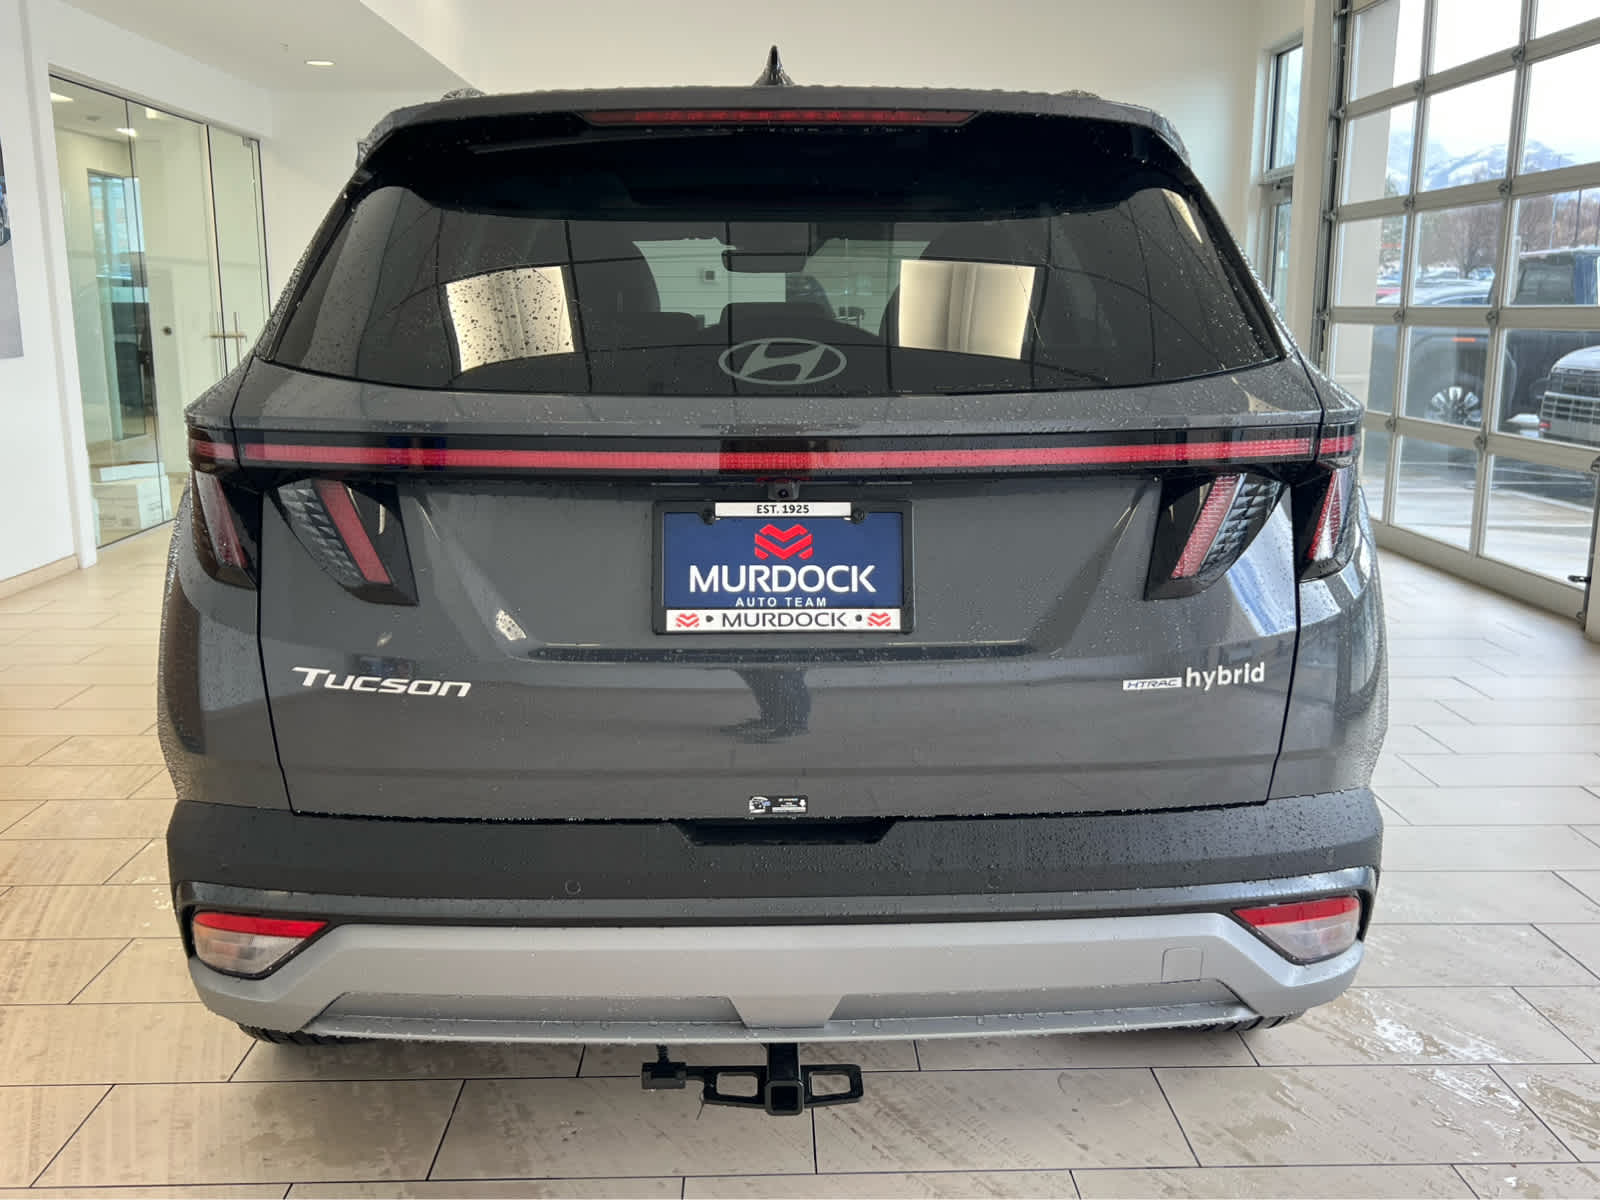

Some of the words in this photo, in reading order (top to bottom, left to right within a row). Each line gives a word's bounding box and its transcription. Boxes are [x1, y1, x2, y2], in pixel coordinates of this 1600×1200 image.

[756, 504, 780, 514] EST.
[782, 504, 810, 514] 1925
[689, 565, 877, 593] MURDOCK
[735, 597, 777, 607] AUTO
[785, 597, 827, 607] TEAM
[722, 612, 848, 628] MURDOCK
[1125, 678, 1179, 690] HTRAC
[1185, 661, 1265, 691] hybrid
